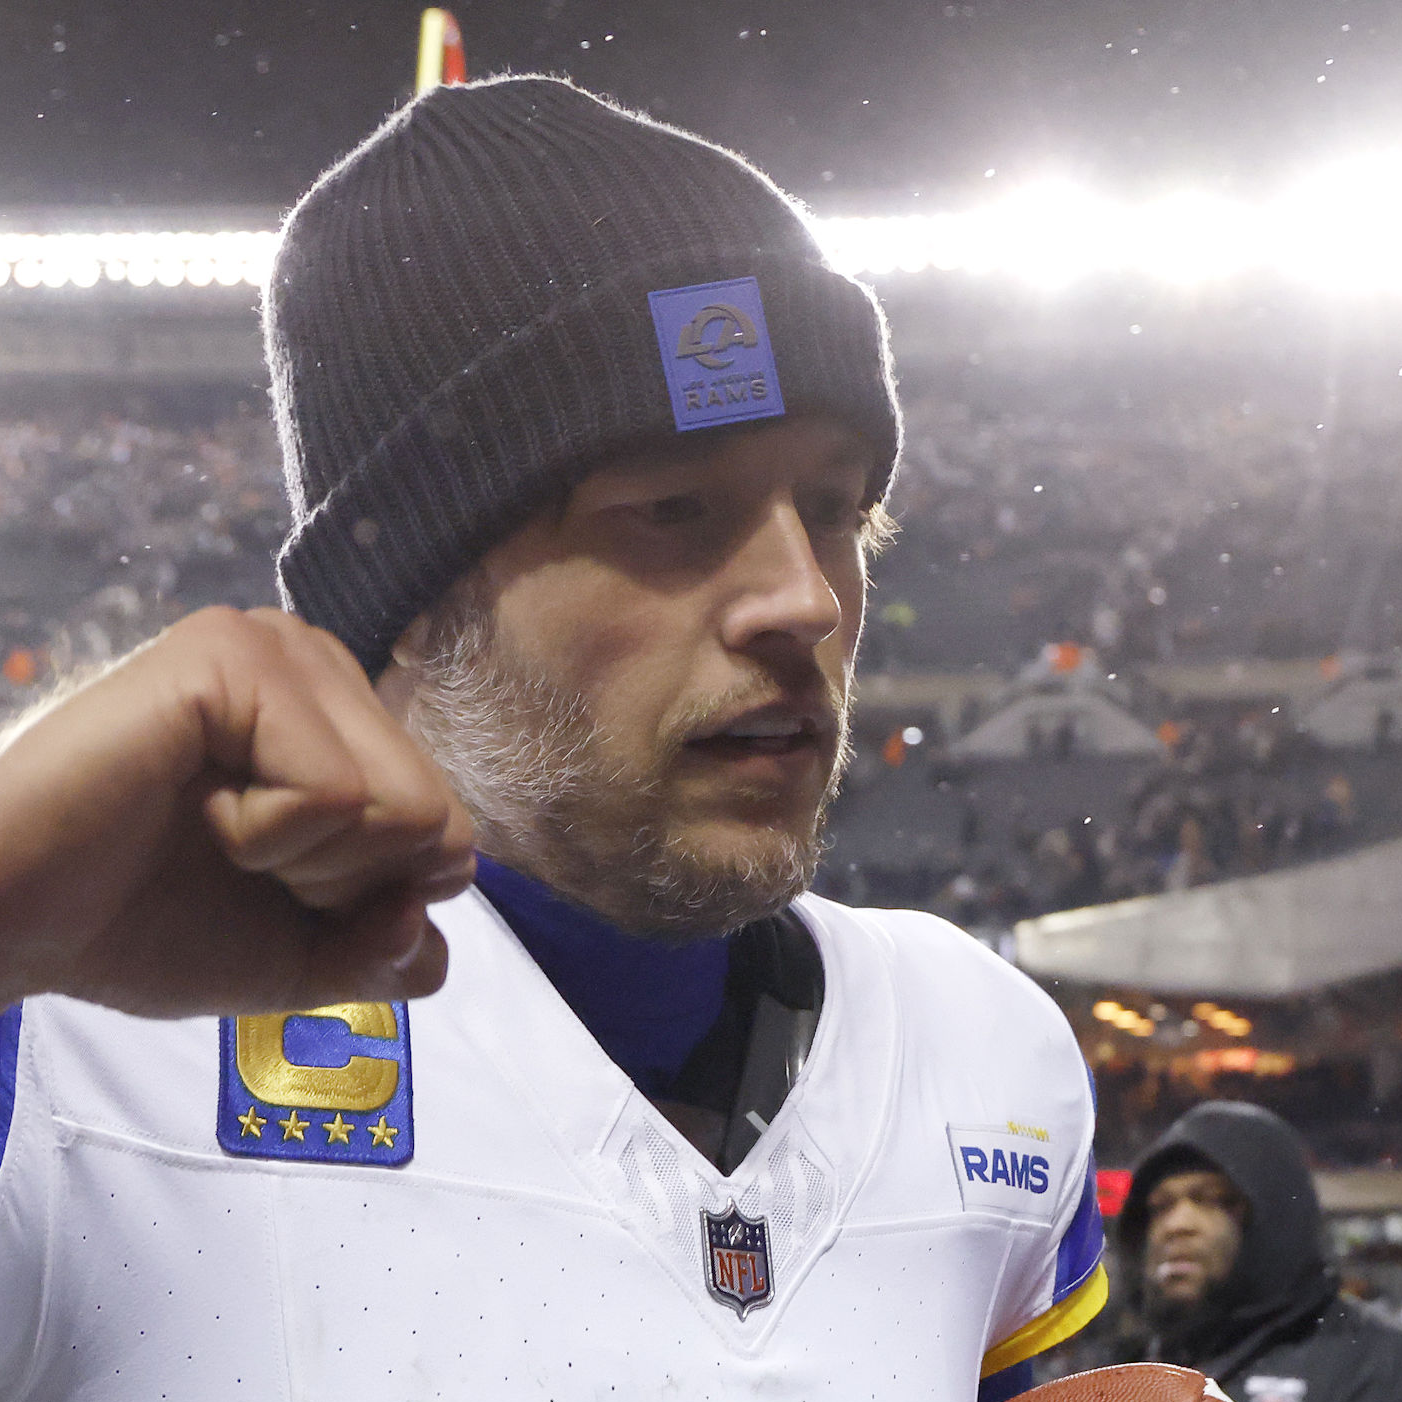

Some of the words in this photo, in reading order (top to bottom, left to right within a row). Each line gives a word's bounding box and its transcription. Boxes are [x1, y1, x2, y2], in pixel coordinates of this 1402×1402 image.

[236, 1002, 399, 1111] C
[959, 1146, 1049, 1194] RAMS
[716, 1250, 765, 1295] NFL
